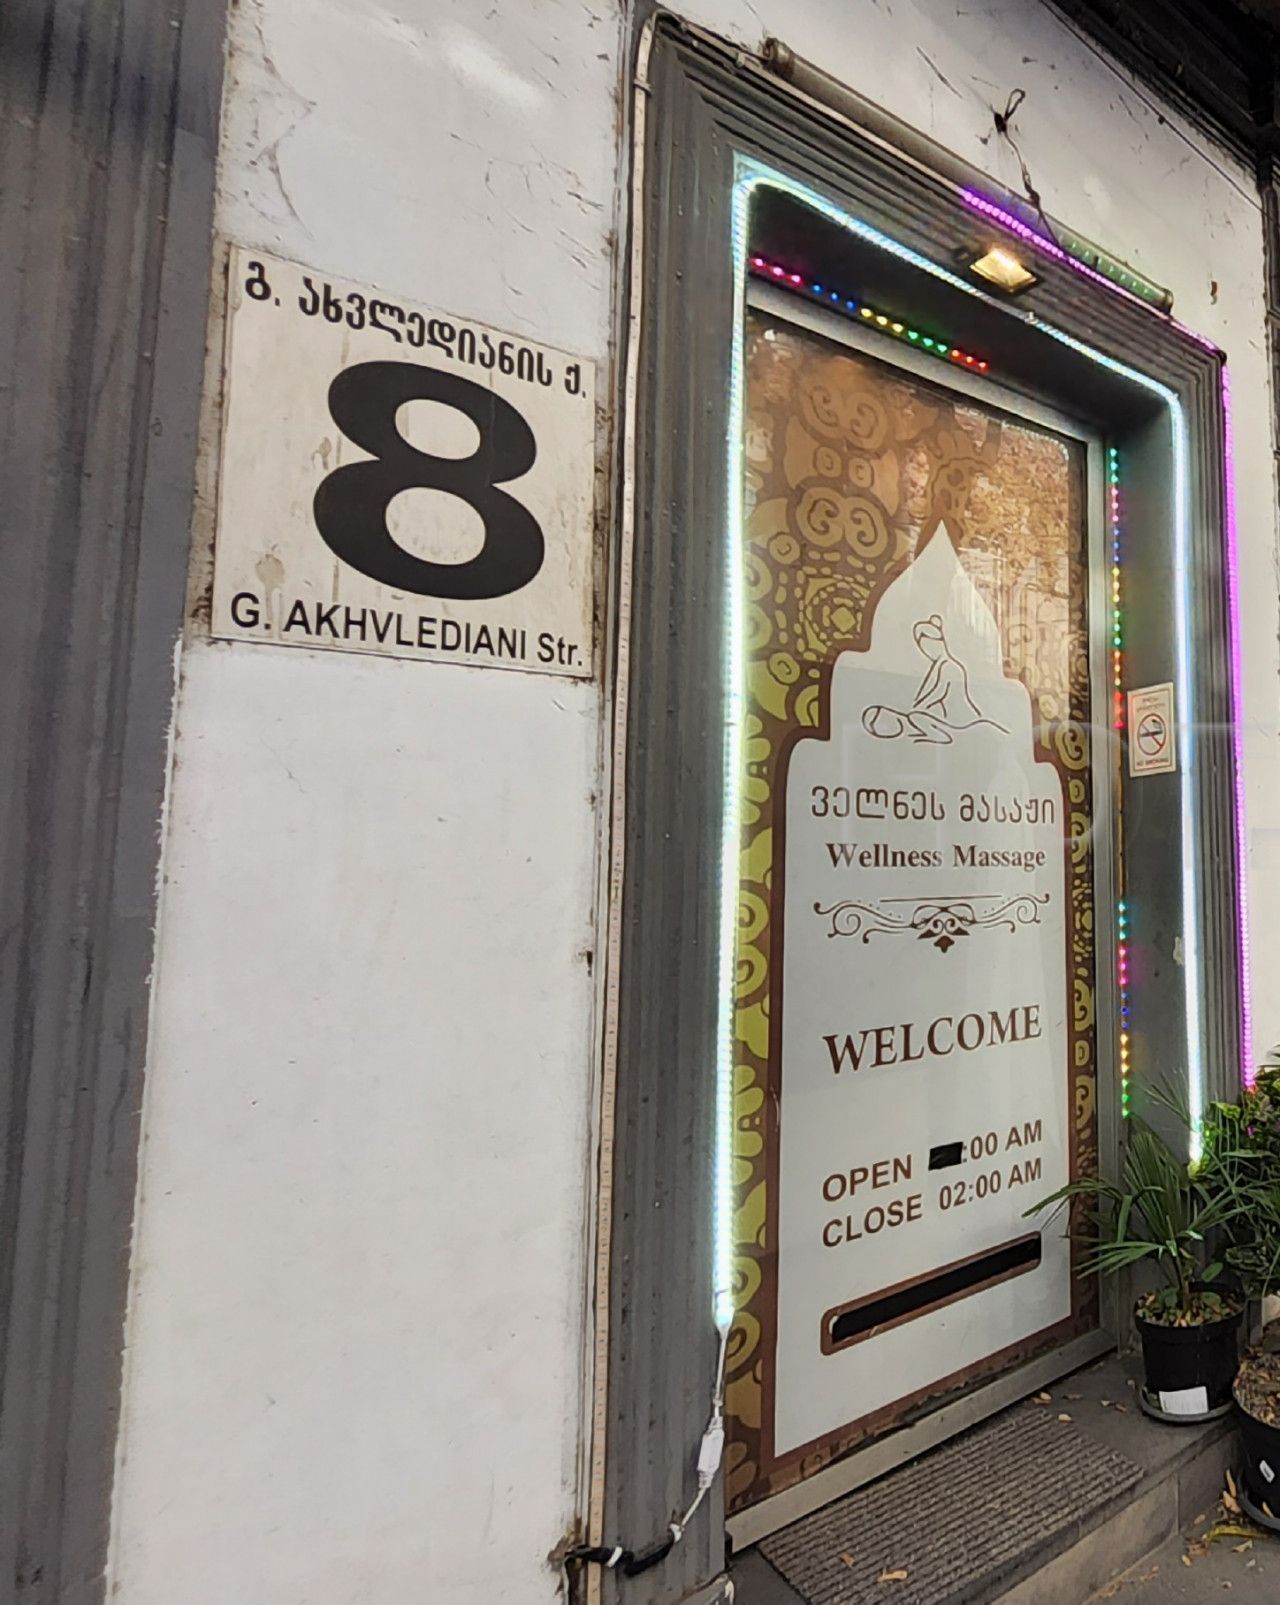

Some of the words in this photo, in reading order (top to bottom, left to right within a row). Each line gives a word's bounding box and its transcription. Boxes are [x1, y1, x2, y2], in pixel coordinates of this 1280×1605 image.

[245, 261, 280, 306] გ.
[299, 276, 552, 387] ახვლედიანის
[564, 363, 587, 398] ქ.
[312, 360, 545, 600] 8
[230, 592, 271, 630] G.
[283, 600, 526, 660] AKHVLEDIANI
[536, 632, 583, 667] Str.
[811, 785, 945, 821] ველნეს
[959, 793, 1055, 824] მასაჟი
[825, 842, 943, 868] Wellness
[952, 844, 1046, 872] Massage
[822, 1004, 1042, 1075] WELCOME
[822, 1154, 912, 1201] OPEN
[1005, 1119, 1042, 1151] AM
[822, 1194, 923, 1247] CLOSE
[939, 1170, 1001, 1210] 02:00
[1008, 1157, 1042, 1189] AM
